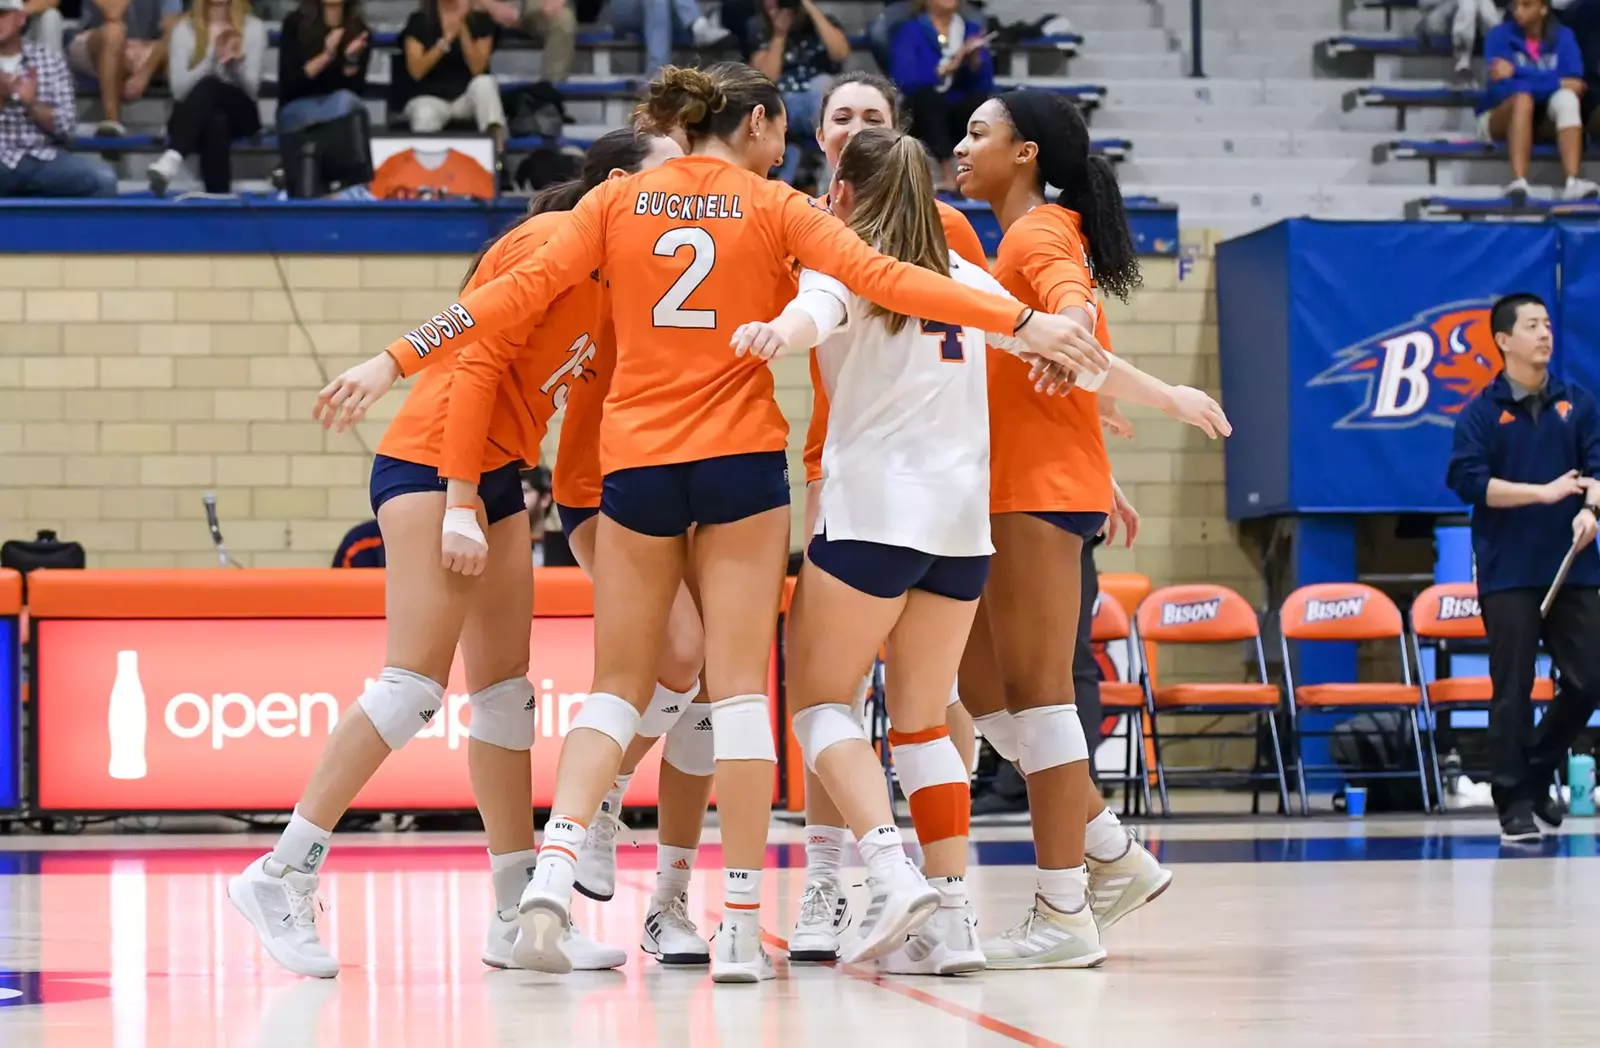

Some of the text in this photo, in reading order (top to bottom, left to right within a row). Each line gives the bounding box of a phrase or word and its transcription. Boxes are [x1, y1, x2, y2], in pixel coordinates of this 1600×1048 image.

[652, 225, 717, 329] 2
[403, 303, 475, 358] BISON
[1371, 330, 1434, 418] B
[1163, 601, 1218, 626] BISON
[1305, 598, 1362, 620] BISON
[1438, 596, 1482, 620] BIS
[164, 692, 339, 750] open
[555, 822, 573, 831] BYE
[878, 827, 895, 835] BYE
[729, 871, 748, 880] BYE
[946, 876, 963, 884] BYE
